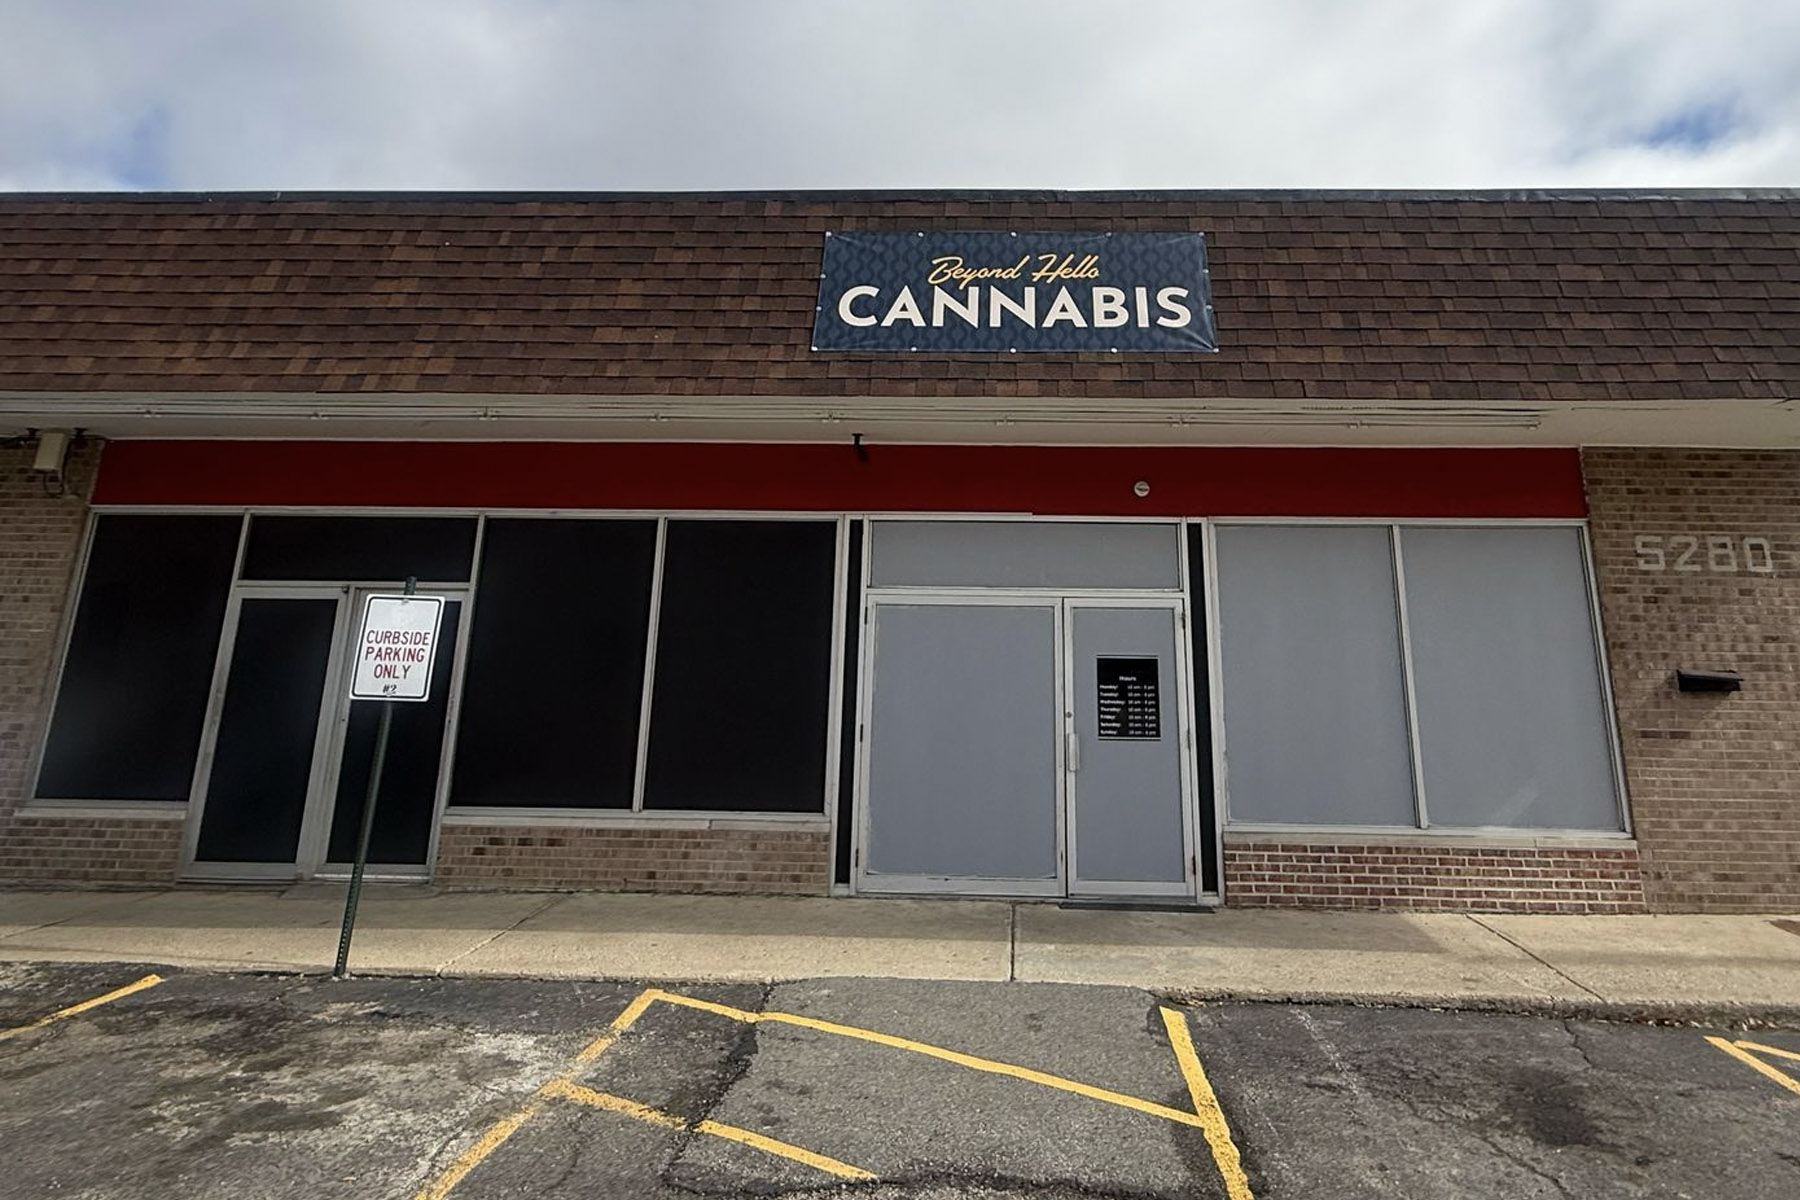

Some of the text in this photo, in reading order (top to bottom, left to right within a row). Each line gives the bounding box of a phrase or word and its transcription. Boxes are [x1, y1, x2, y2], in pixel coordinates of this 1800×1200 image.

[927, 253, 1100, 290] Beyond Hello
[837, 285, 1192, 329] CANNABIS
[1634, 535, 1774, 573] 5280
[366, 629, 431, 646] CURBSIDE
[364, 646, 426, 663] PARKING
[373, 663, 412, 680] ONLY
